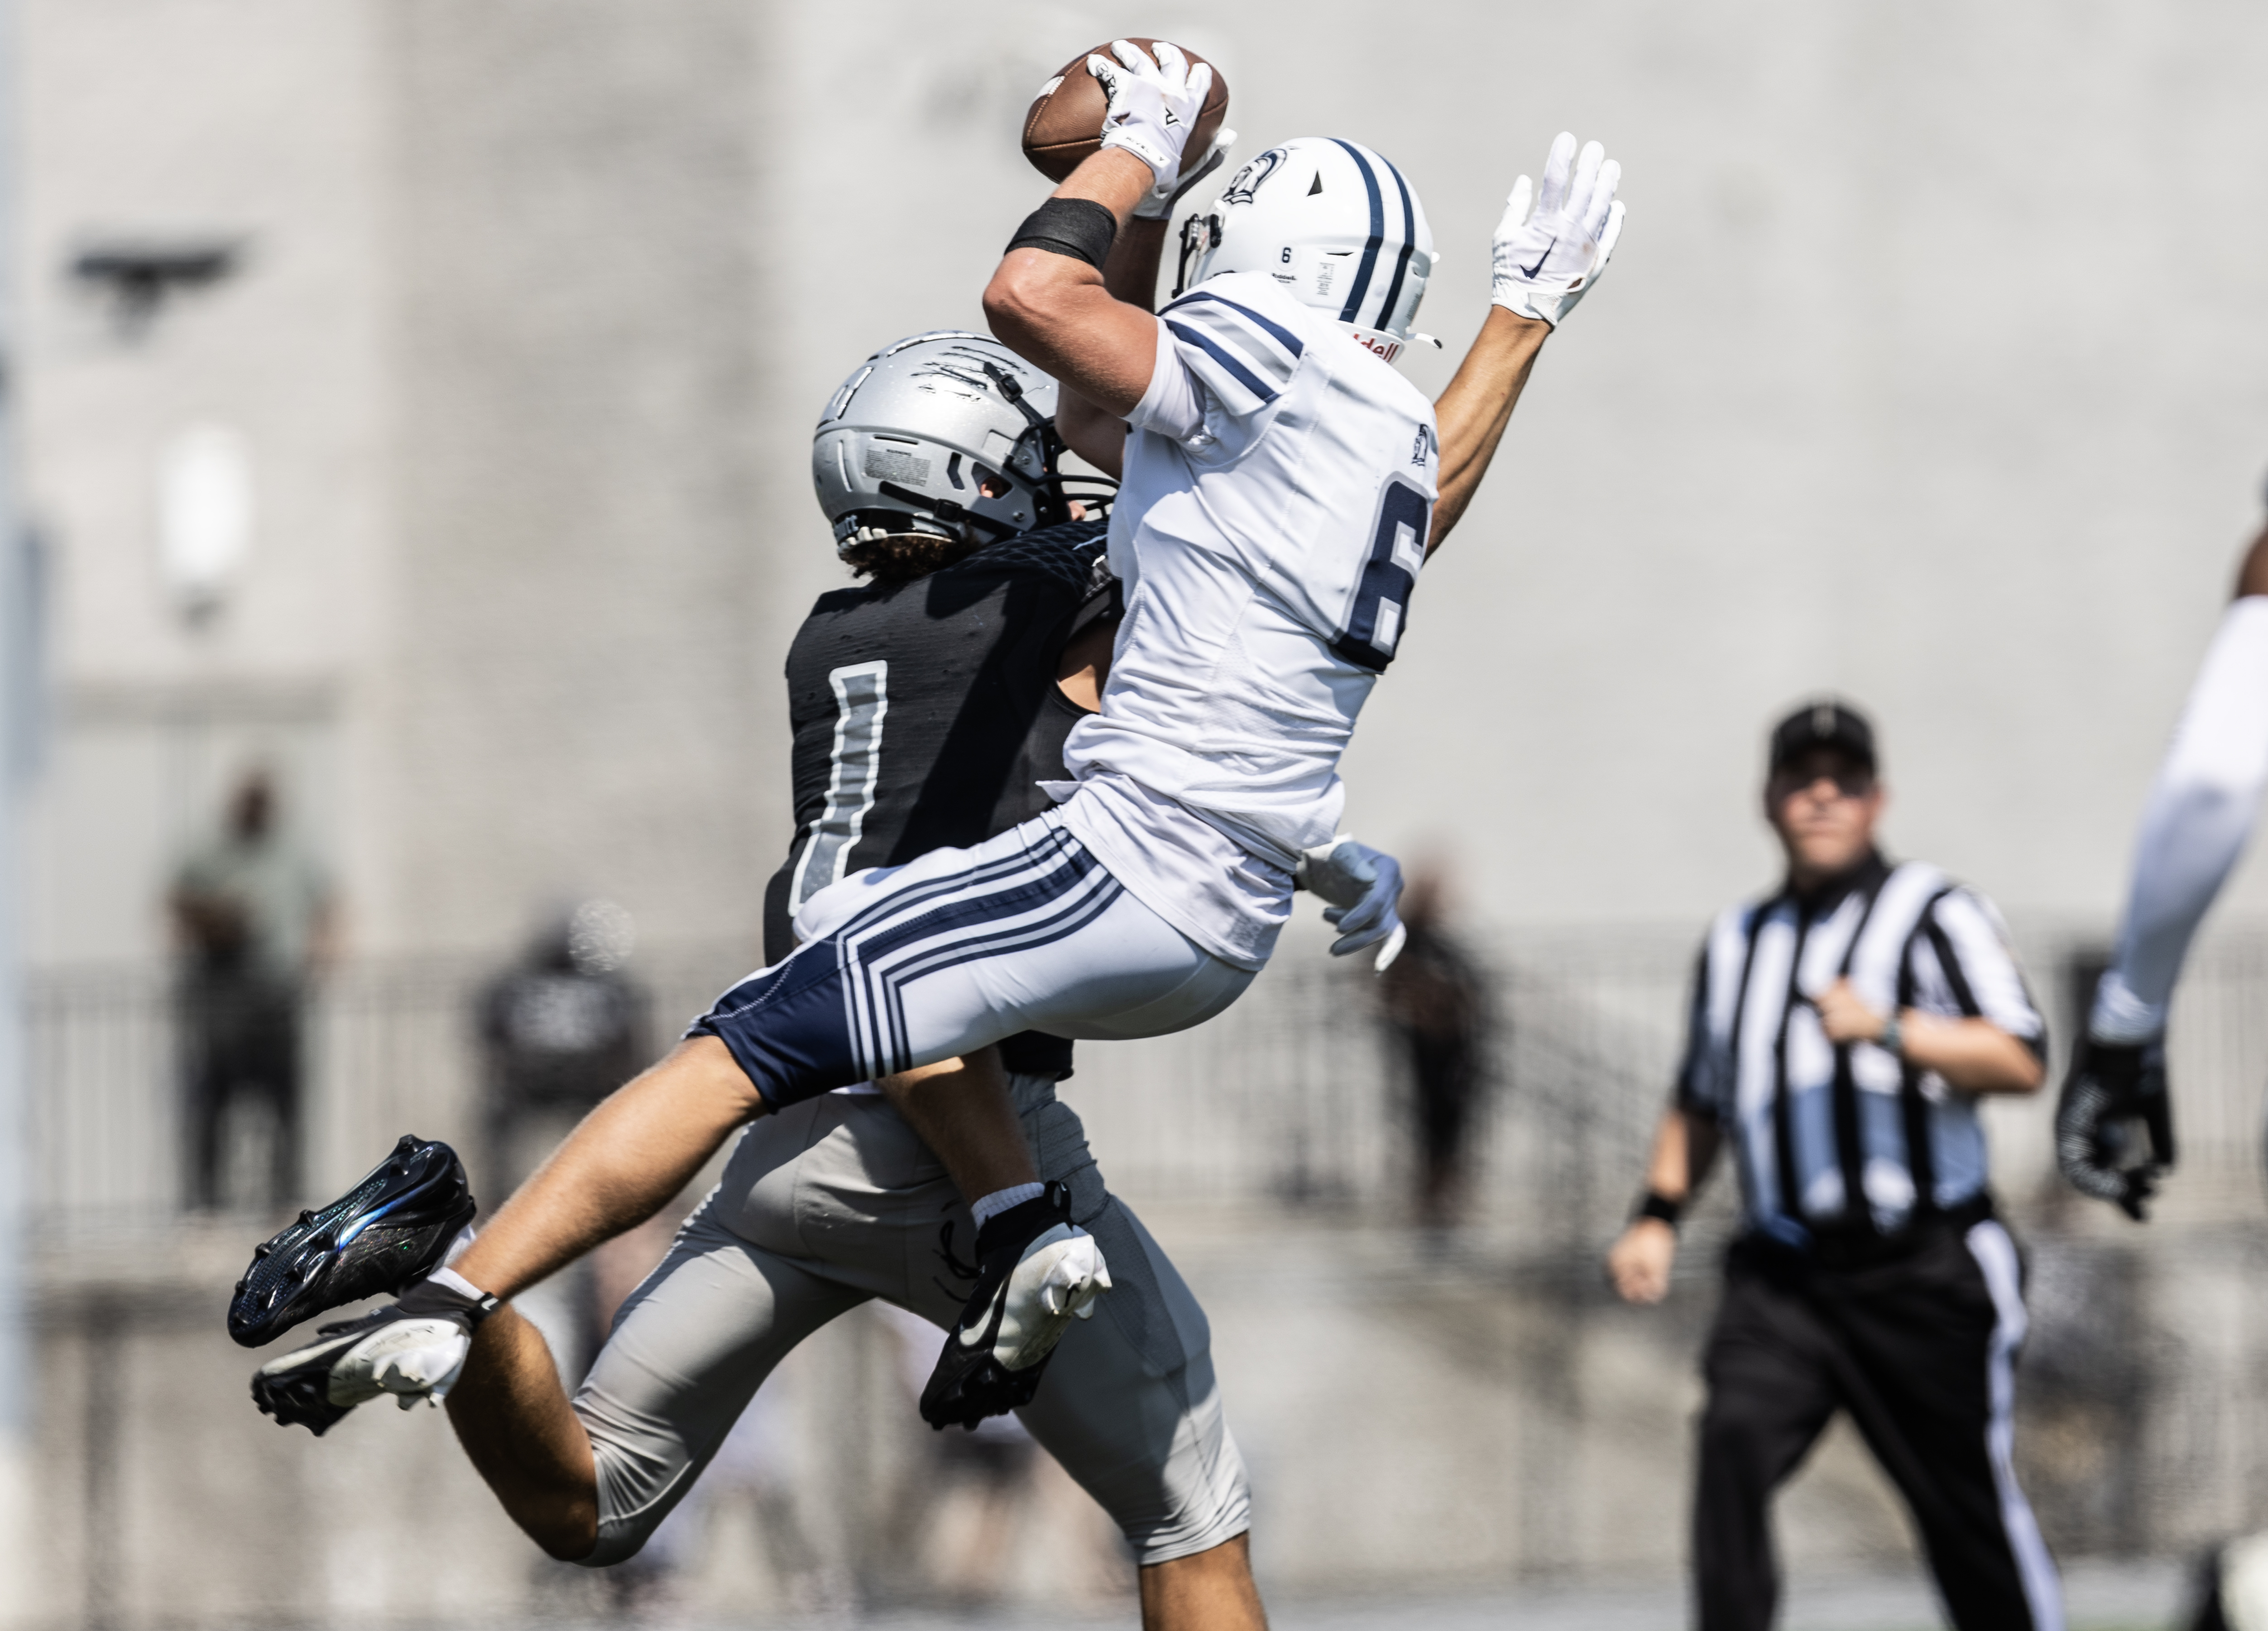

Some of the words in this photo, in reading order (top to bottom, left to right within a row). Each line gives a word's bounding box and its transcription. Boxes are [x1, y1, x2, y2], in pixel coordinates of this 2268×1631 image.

[1282, 247, 1291, 264] 6
[1353, 333, 1400, 363] dell
[788, 659, 888, 917] 1
